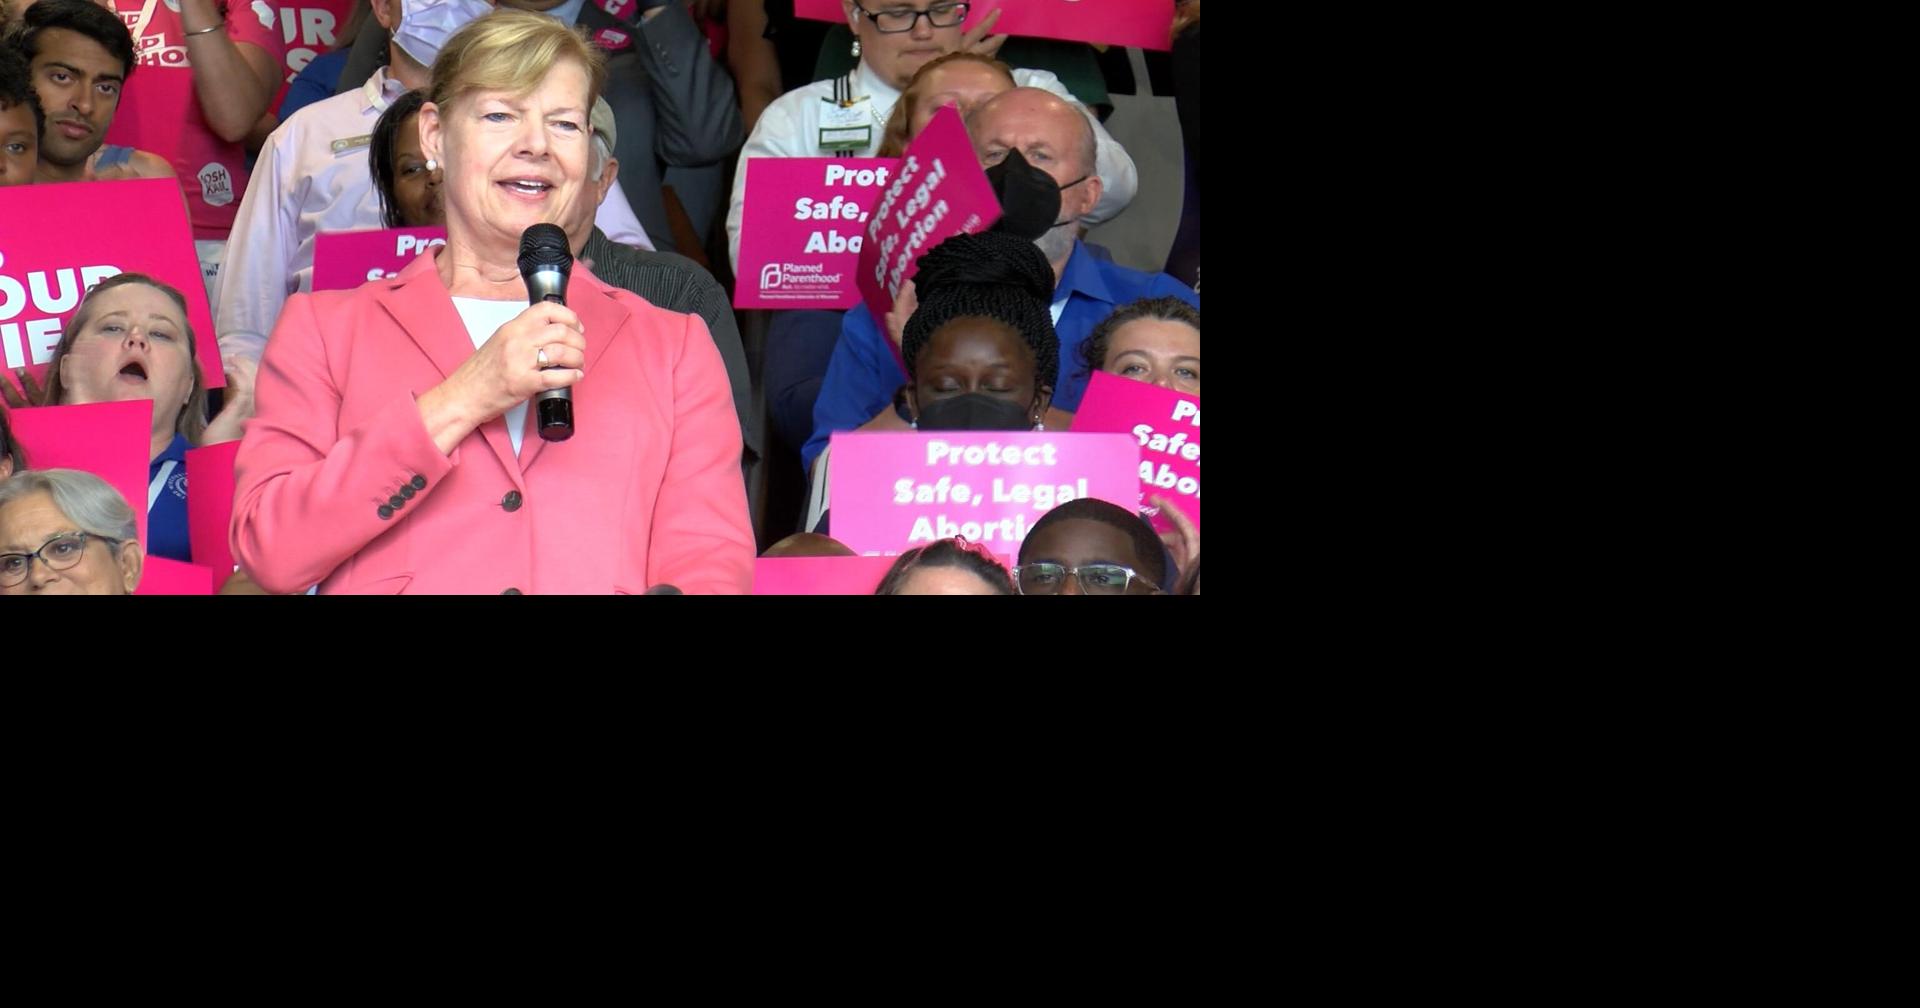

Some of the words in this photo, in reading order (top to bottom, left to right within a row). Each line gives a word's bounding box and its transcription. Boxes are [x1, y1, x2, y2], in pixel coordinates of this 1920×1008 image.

[825, 165, 888, 186] Prot
[896, 158, 947, 229] Legal
[794, 196, 869, 222] Safe,
[783, 262, 823, 272] Planned
[783, 273, 840, 283] Parenthood
[926, 441, 1057, 465] Protect
[1138, 460, 1200, 498] Abo
[894, 476, 984, 507] Safe,
[993, 477, 1089, 510] Legal
[908, 515, 1034, 541] Aborti
